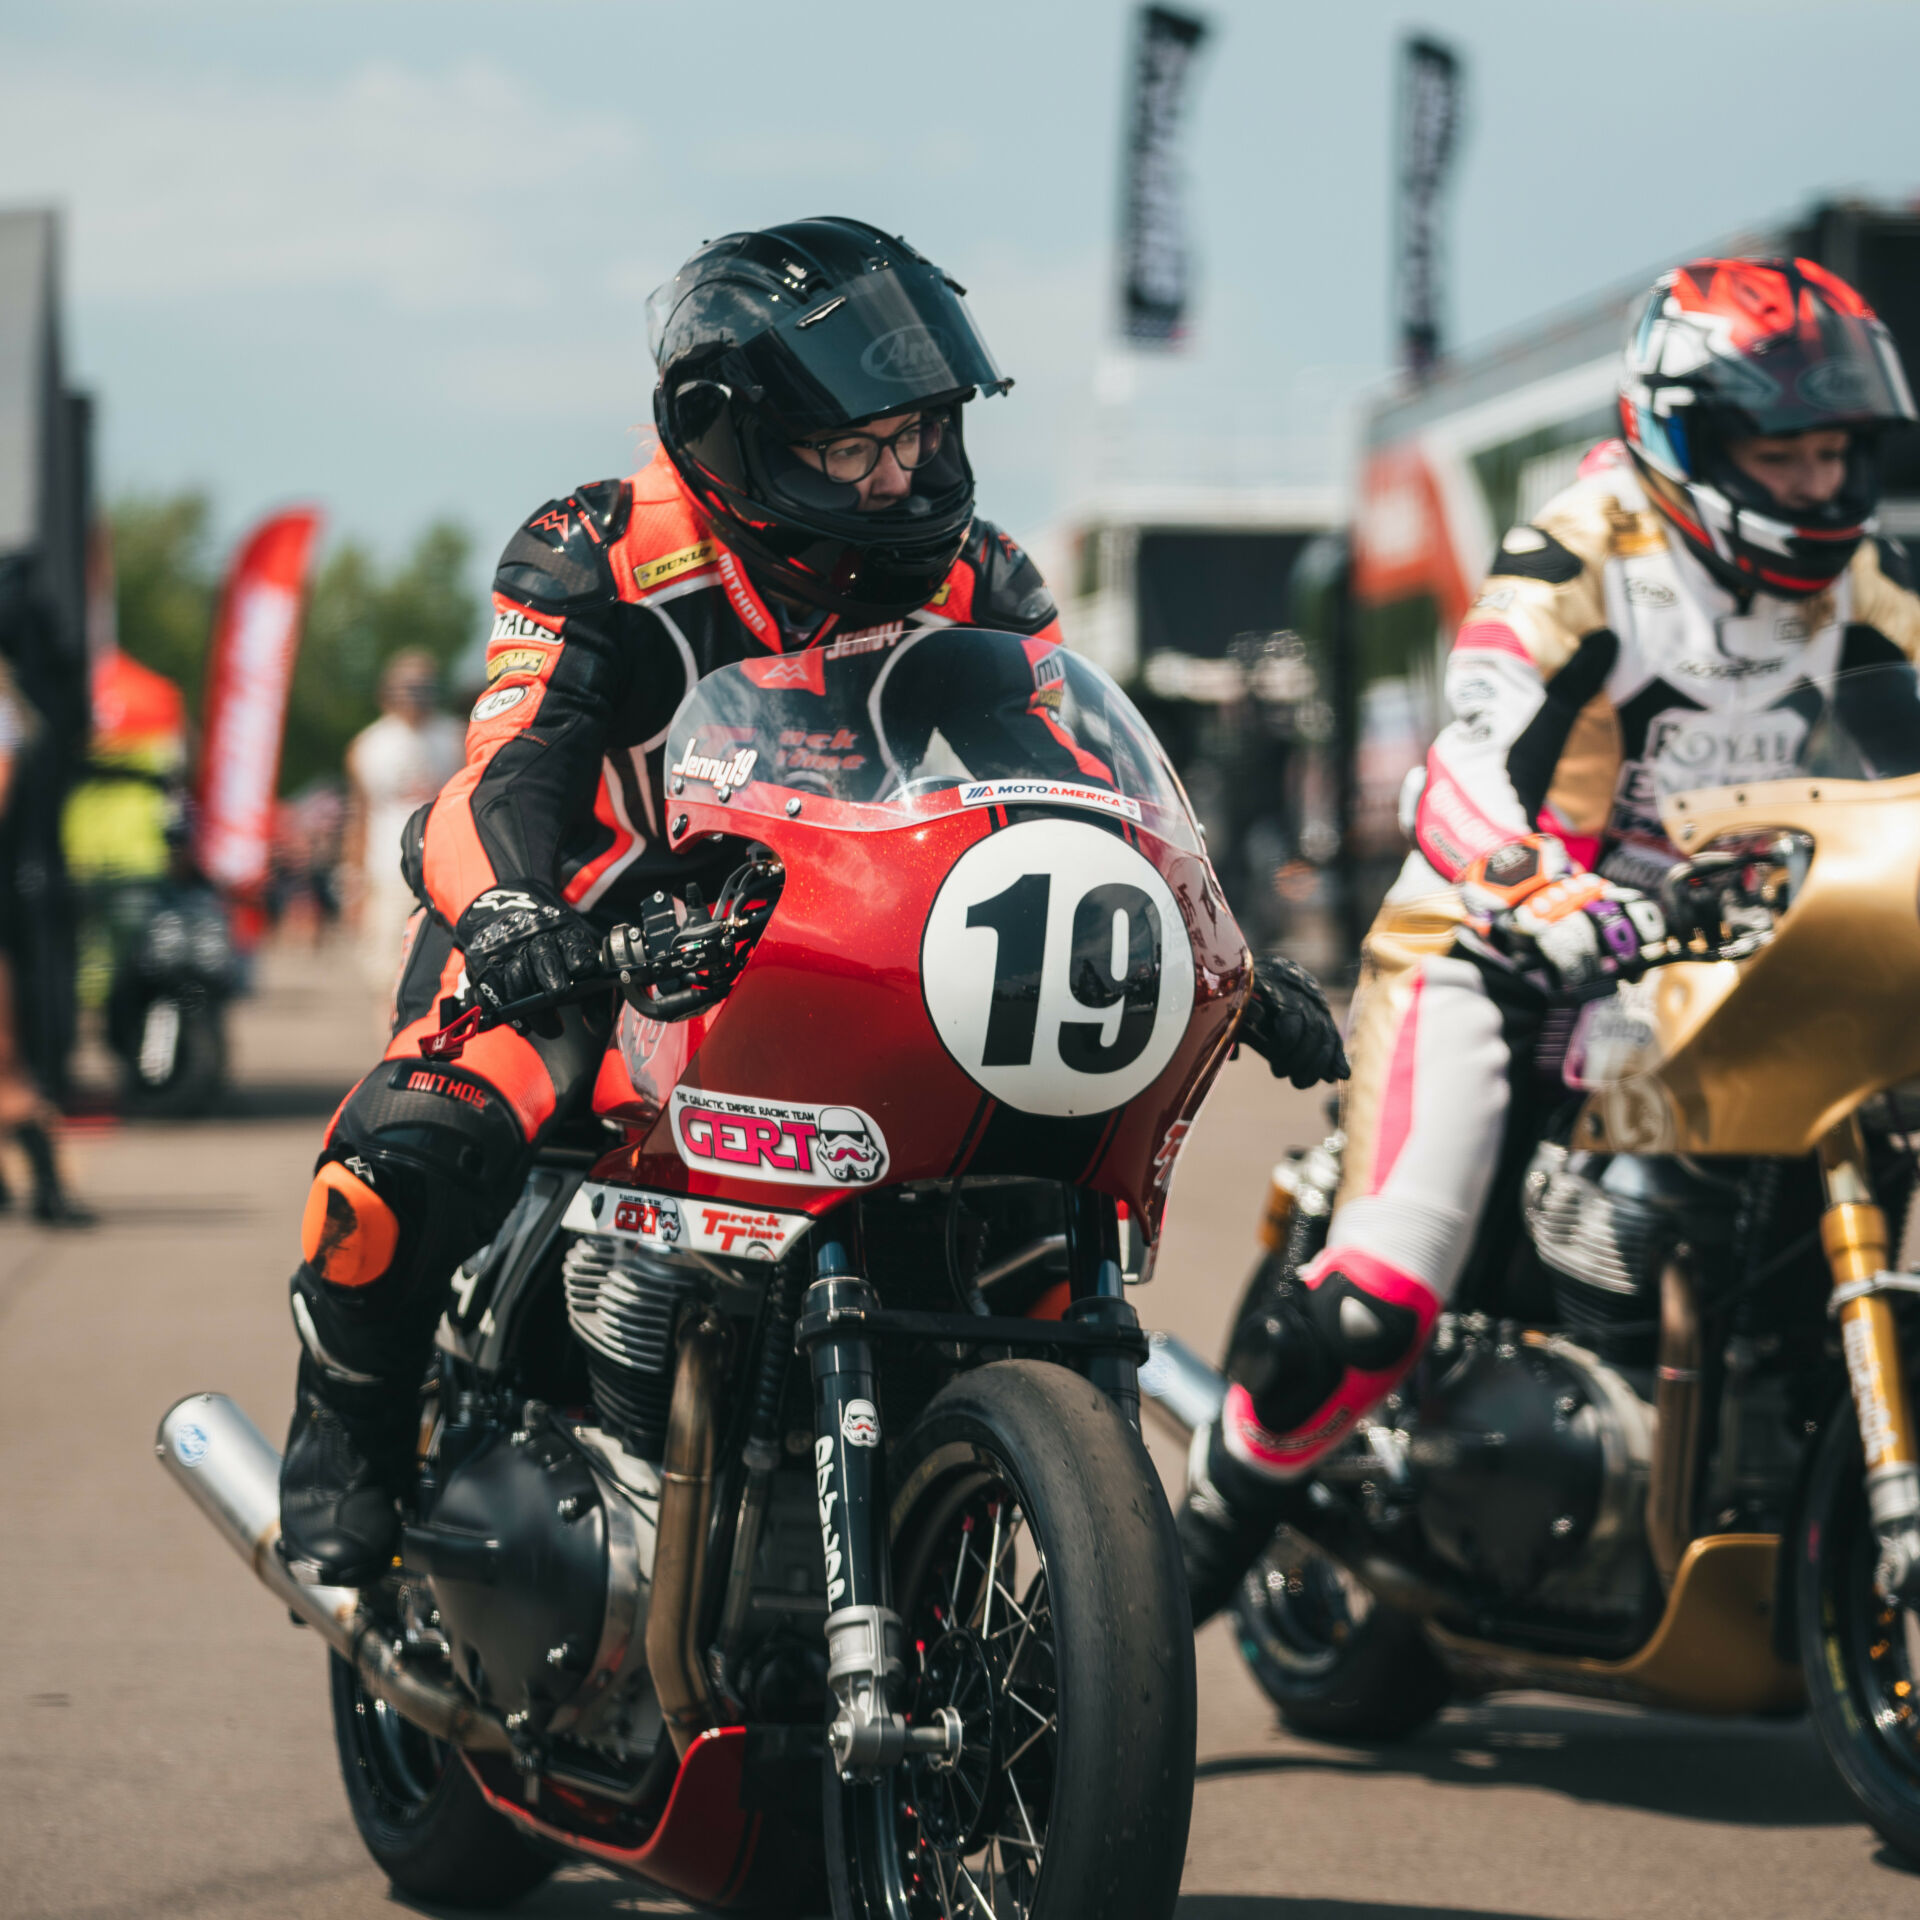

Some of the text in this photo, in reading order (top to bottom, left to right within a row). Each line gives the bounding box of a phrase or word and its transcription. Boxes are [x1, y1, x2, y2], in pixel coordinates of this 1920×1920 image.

[671, 738, 758, 789] Jenny19
[997, 785, 1121, 808] MOTOAMERICA
[966, 873, 1163, 1075] 19
[407, 1071, 487, 1110] MITHOS
[676, 1091, 816, 1121] THE GALACTIC EMPIRE RACING TEAM
[678, 1106, 820, 1172] GERT
[614, 1200, 662, 1235] GERT
[701, 1208, 782, 1235] Track
[716, 1224, 786, 1251] Time
